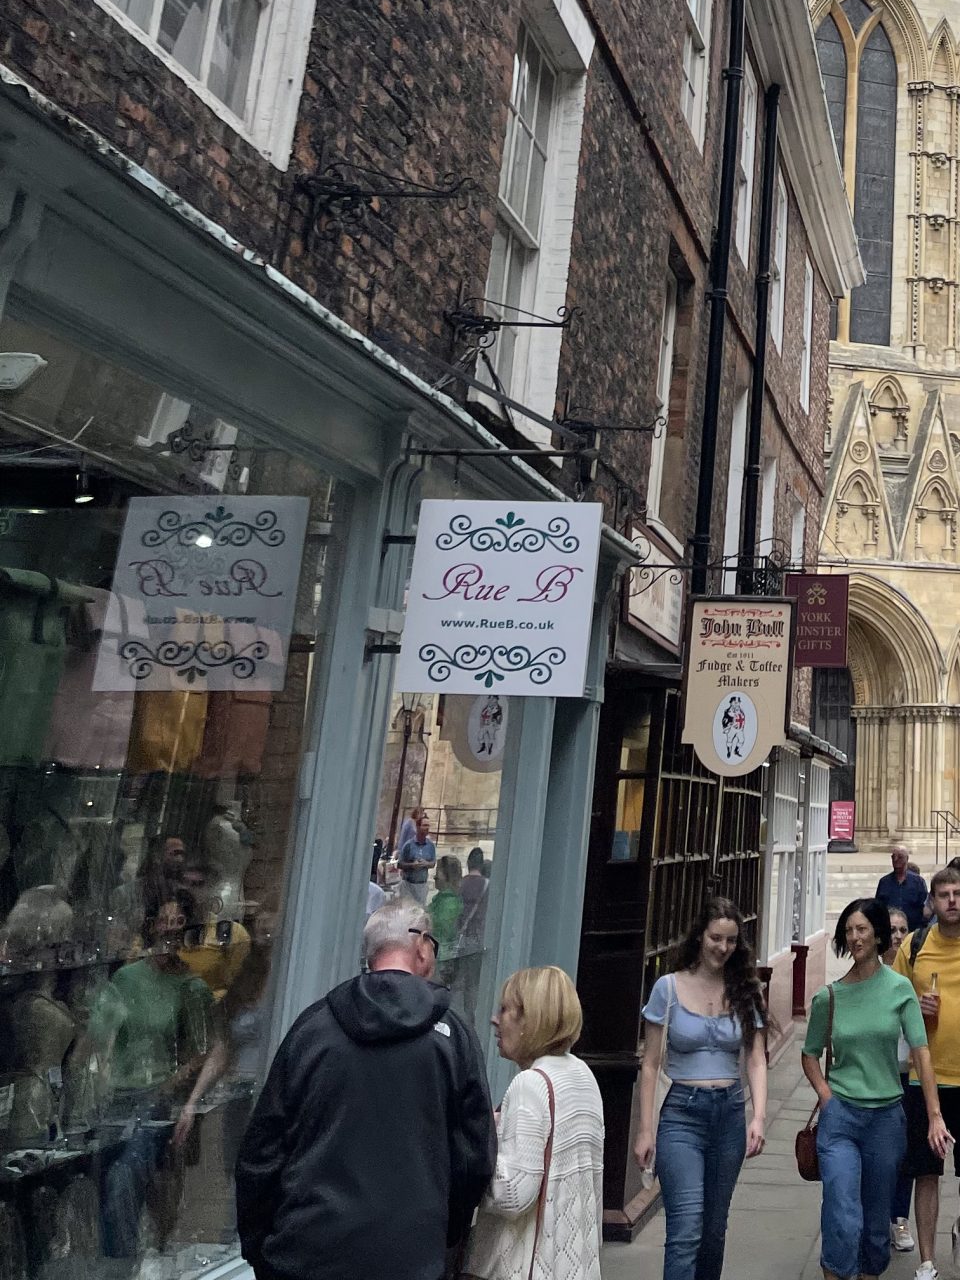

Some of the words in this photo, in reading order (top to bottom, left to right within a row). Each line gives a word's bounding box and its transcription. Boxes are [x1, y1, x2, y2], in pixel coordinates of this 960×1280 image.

[422, 563, 510, 601] Rue
[516, 565, 584, 603] B
[801, 612, 832, 623] YORK
[441, 618, 554, 630] www.RueB.co.uk
[700, 617, 741, 639] John
[746, 618, 784, 639] Bull
[798, 640, 832, 650] GIFTS
[696, 659, 732, 673] Fudge
[735, 660, 745, 671] &
[749, 661, 783, 672] Toffee
[717, 675, 760, 687] Makers
